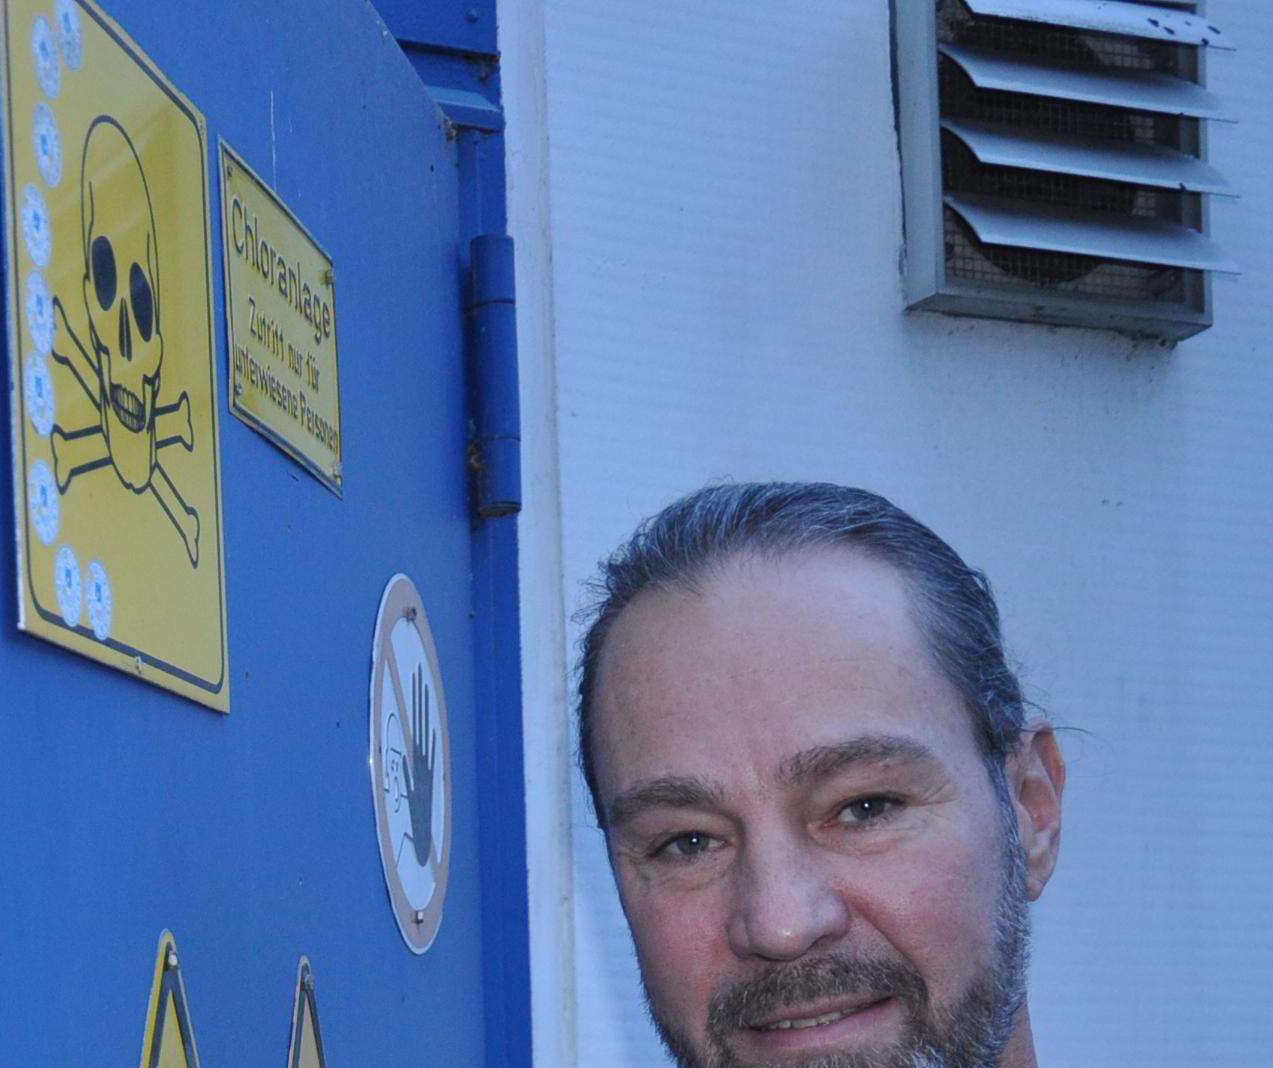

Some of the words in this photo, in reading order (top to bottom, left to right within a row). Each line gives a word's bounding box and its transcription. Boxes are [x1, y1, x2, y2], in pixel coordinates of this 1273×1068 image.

[231, 198, 331, 341] Chloranlage
[234, 345, 299, 420] unterwiesene
[299, 391, 339, 454] Personen
[248, 297, 285, 360] Zutritt
[288, 344, 305, 378] nur
[305, 351, 321, 394] für
